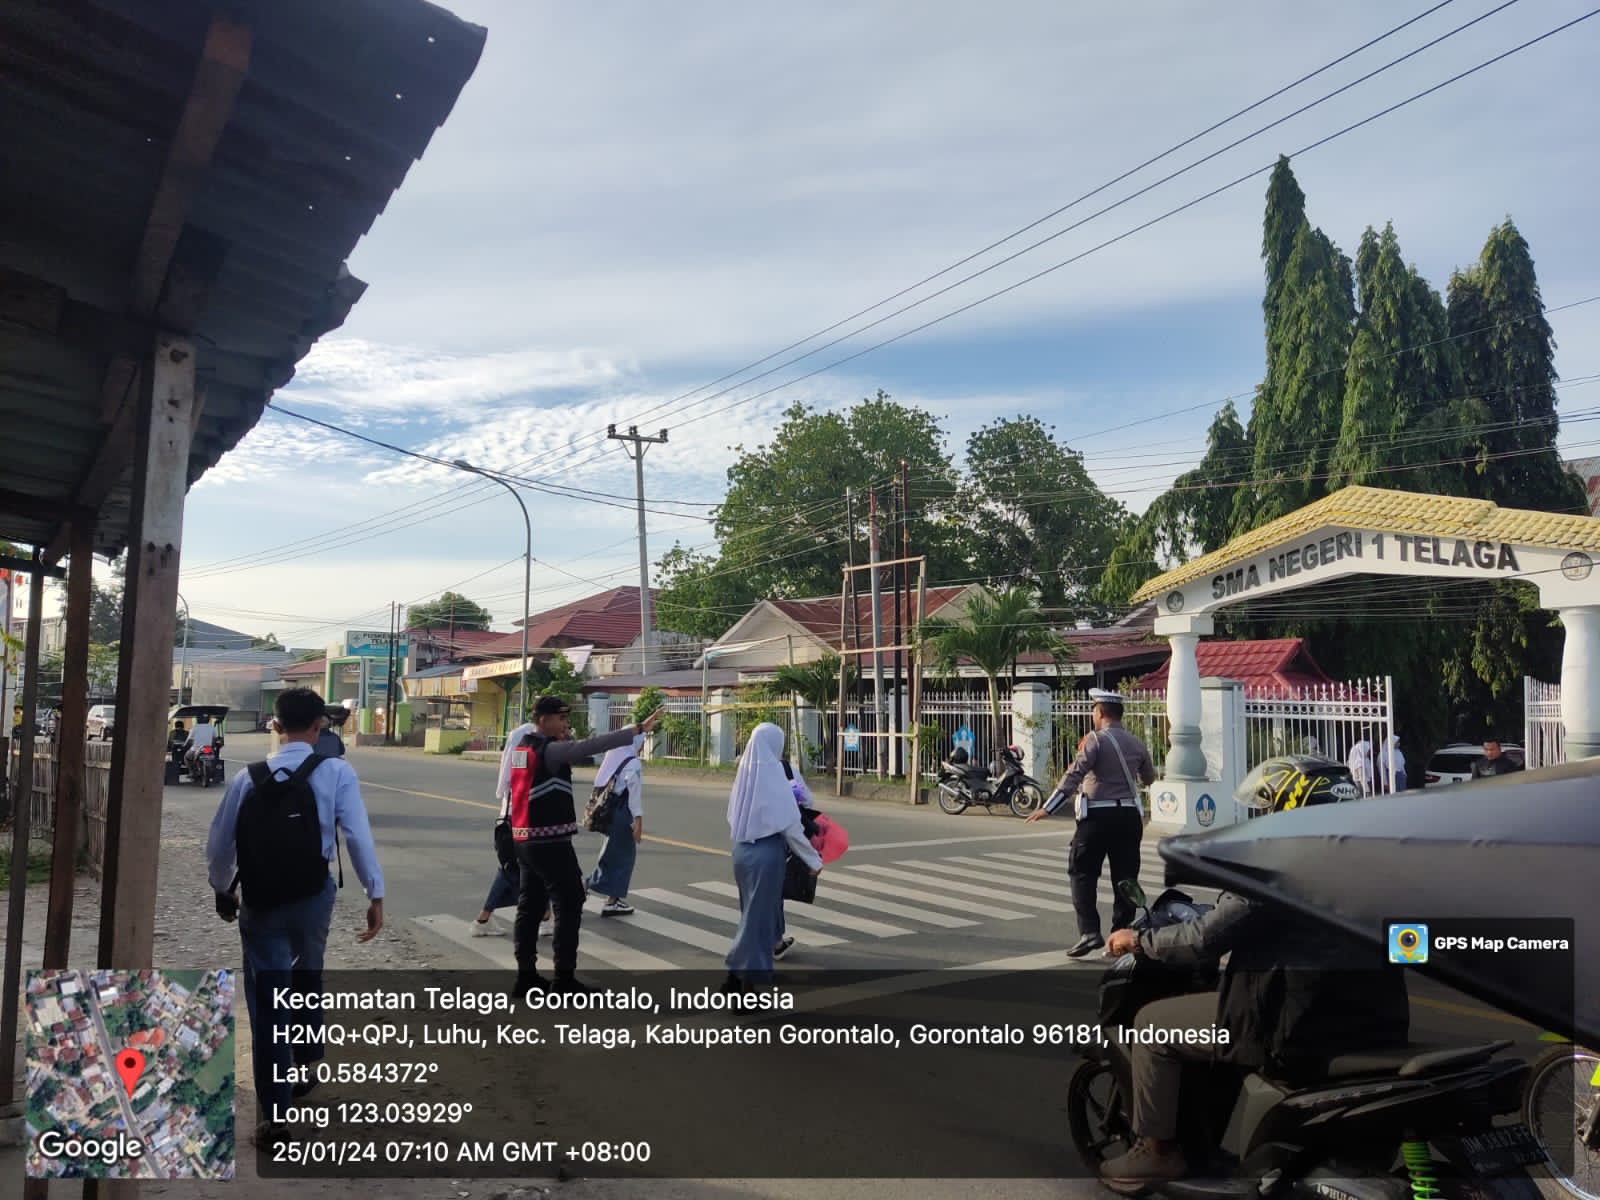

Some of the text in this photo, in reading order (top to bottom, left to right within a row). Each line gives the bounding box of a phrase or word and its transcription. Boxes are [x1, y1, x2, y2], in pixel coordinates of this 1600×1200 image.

[1212, 531, 1520, 600] SMA NEGERI 1 TELAGA
